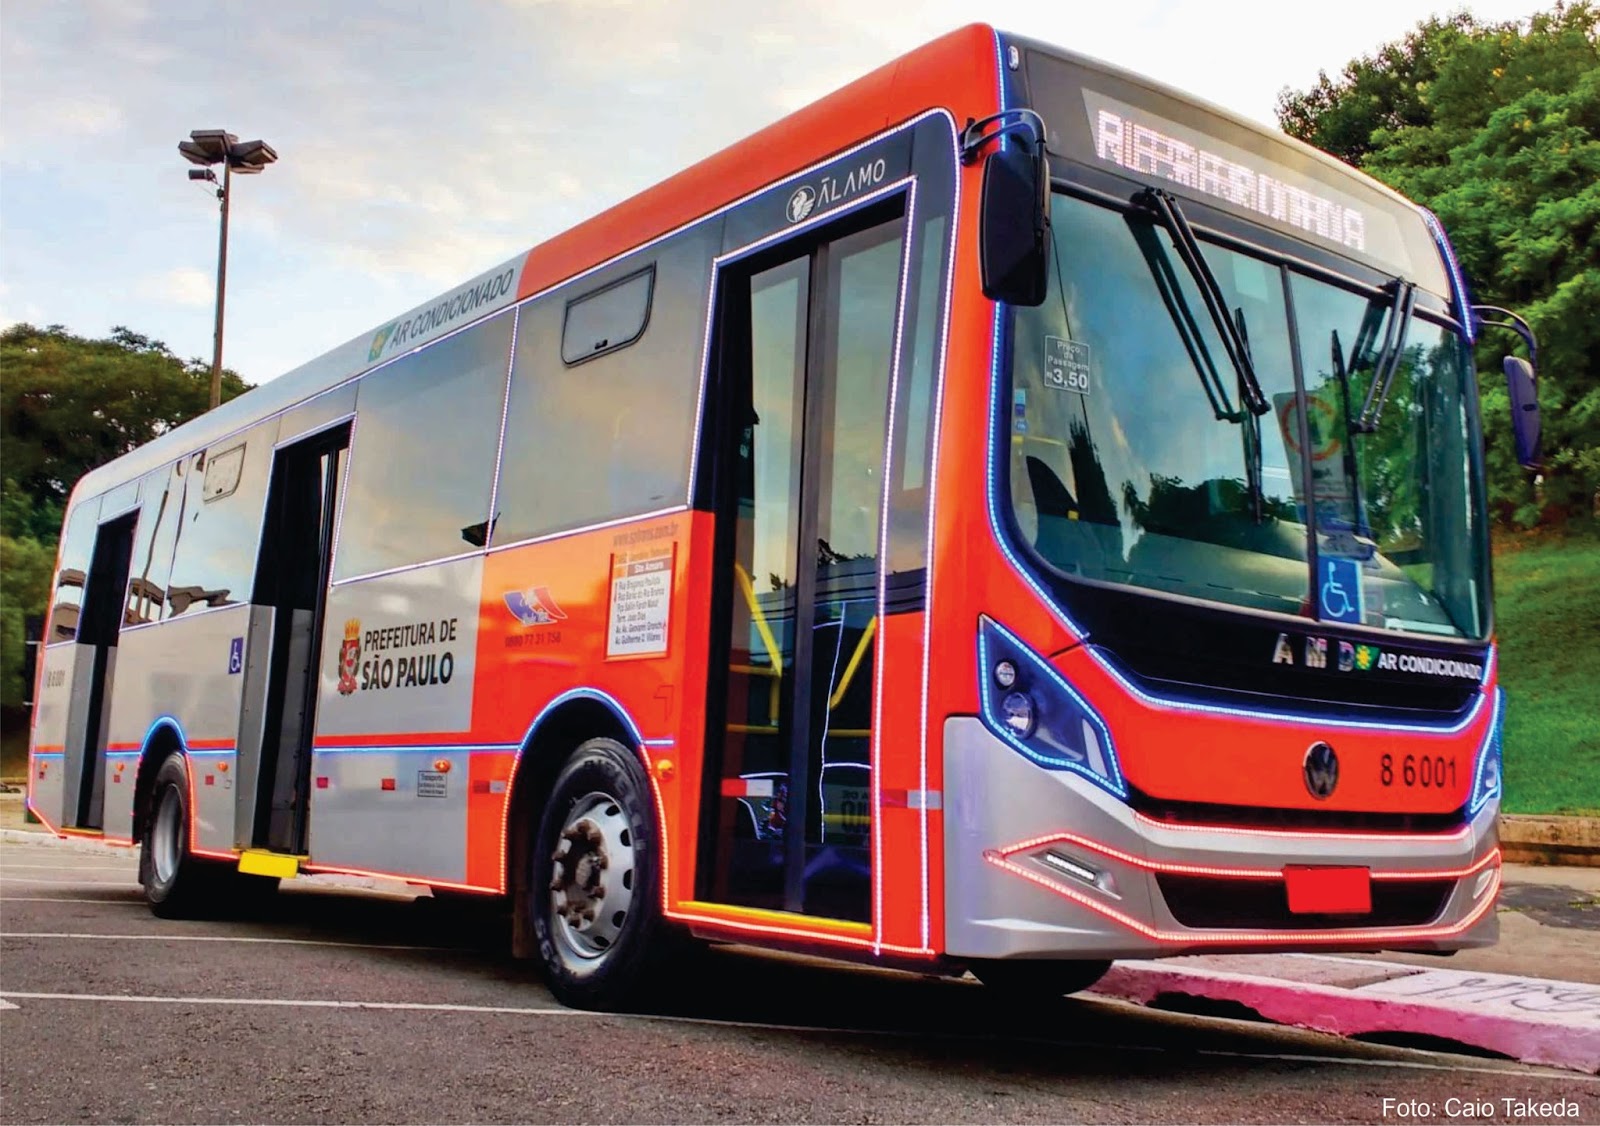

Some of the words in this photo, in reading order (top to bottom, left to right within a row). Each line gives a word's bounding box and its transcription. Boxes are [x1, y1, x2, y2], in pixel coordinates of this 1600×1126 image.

[389, 320, 412, 349] AR
[411, 268, 515, 338] CONDICIONADO
[1053, 368, 1088, 389] 3,50
[364, 621, 435, 651] PREFEITURA
[439, 618, 458, 642] DE
[361, 654, 393, 690] SÃO
[396, 652, 454, 688] PAULO
[1377, 652, 1398, 670] AR
[1399, 654, 1482, 680] CONDICIONADO
[1380, 754, 1394, 786] 8
[1403, 754, 1457, 787] 6001
